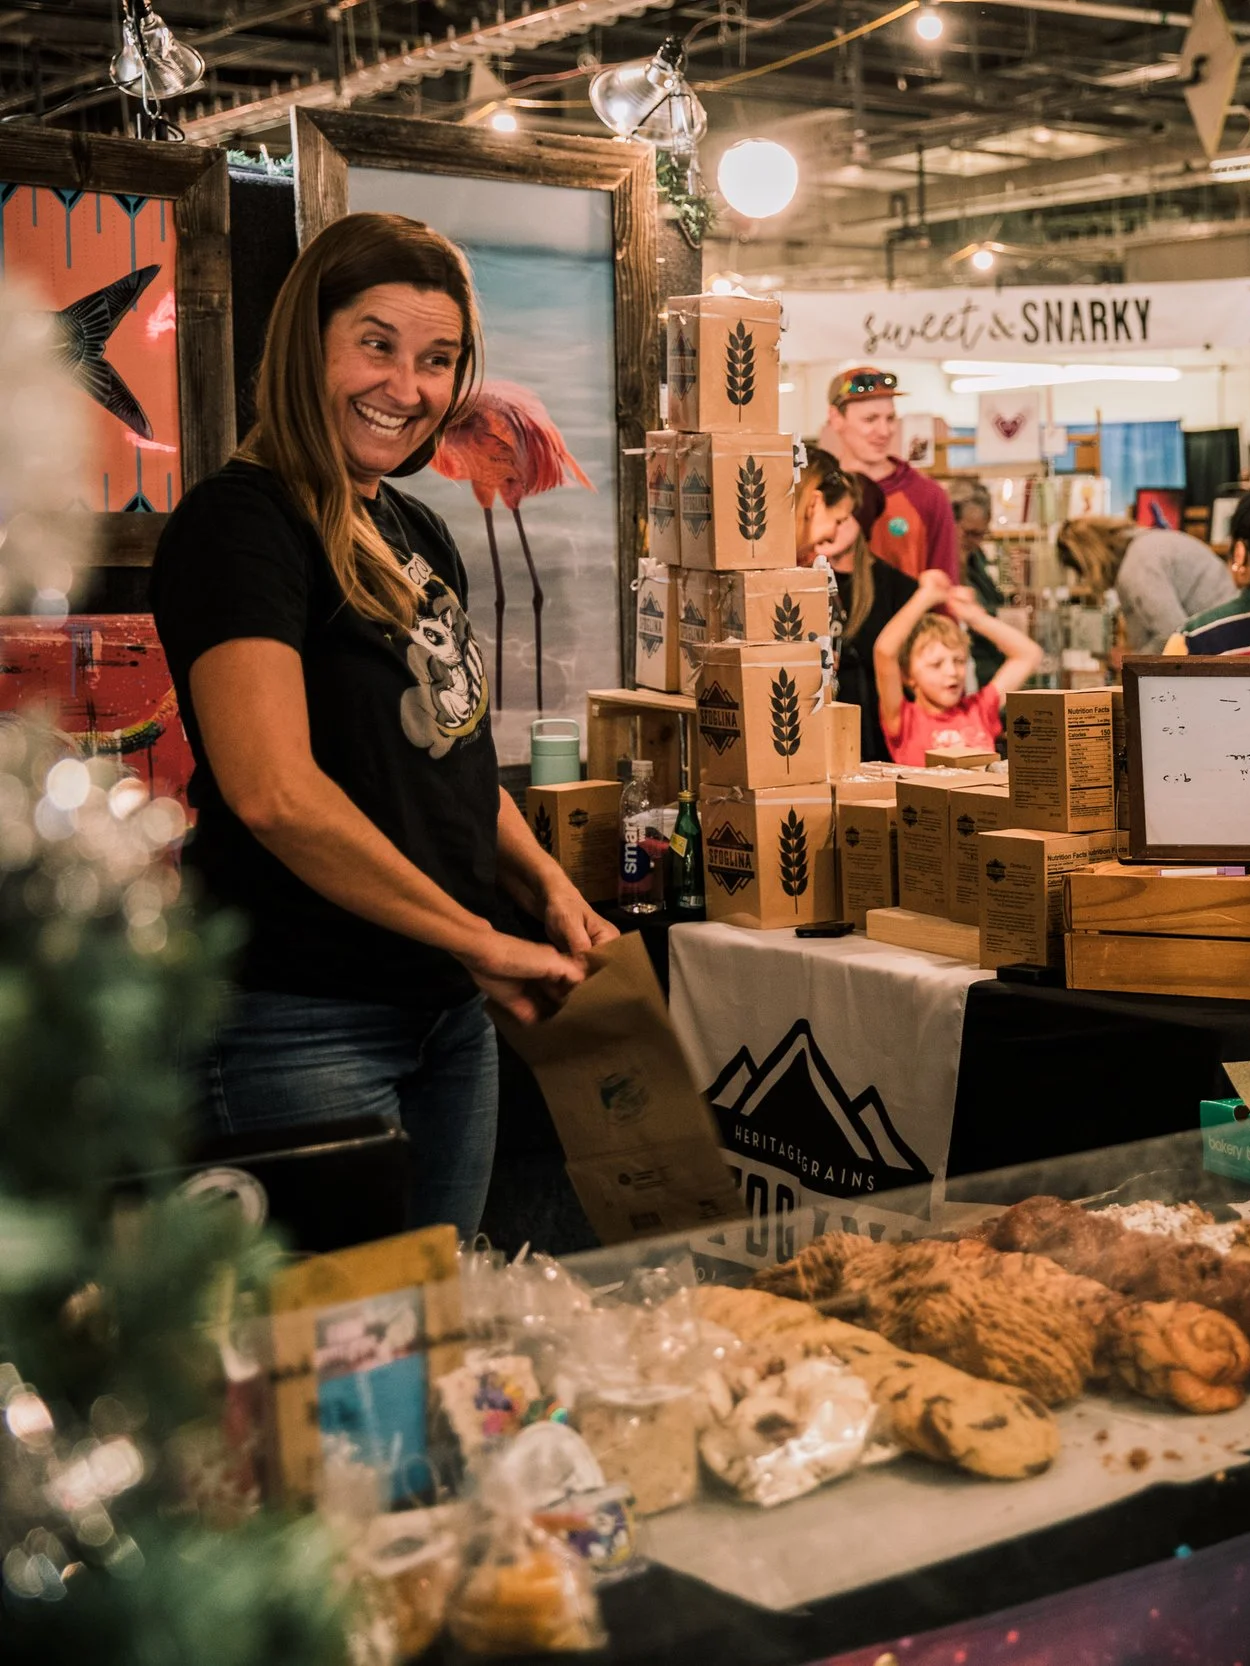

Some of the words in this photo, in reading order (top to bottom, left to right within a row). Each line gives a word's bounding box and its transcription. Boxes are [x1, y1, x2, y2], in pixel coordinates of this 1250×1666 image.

[863, 298, 983, 354] sweet
[988, 311, 1016, 342] &
[1021, 299, 1150, 343] SNARKY
[700, 708, 738, 728] SFOGLINA
[708, 848, 752, 869] SFOGLINA
[735, 1124, 801, 1165] HERITAGE
[800, 1155, 876, 1192] GRAINS
[1208, 1135, 1243, 1160] bakery
